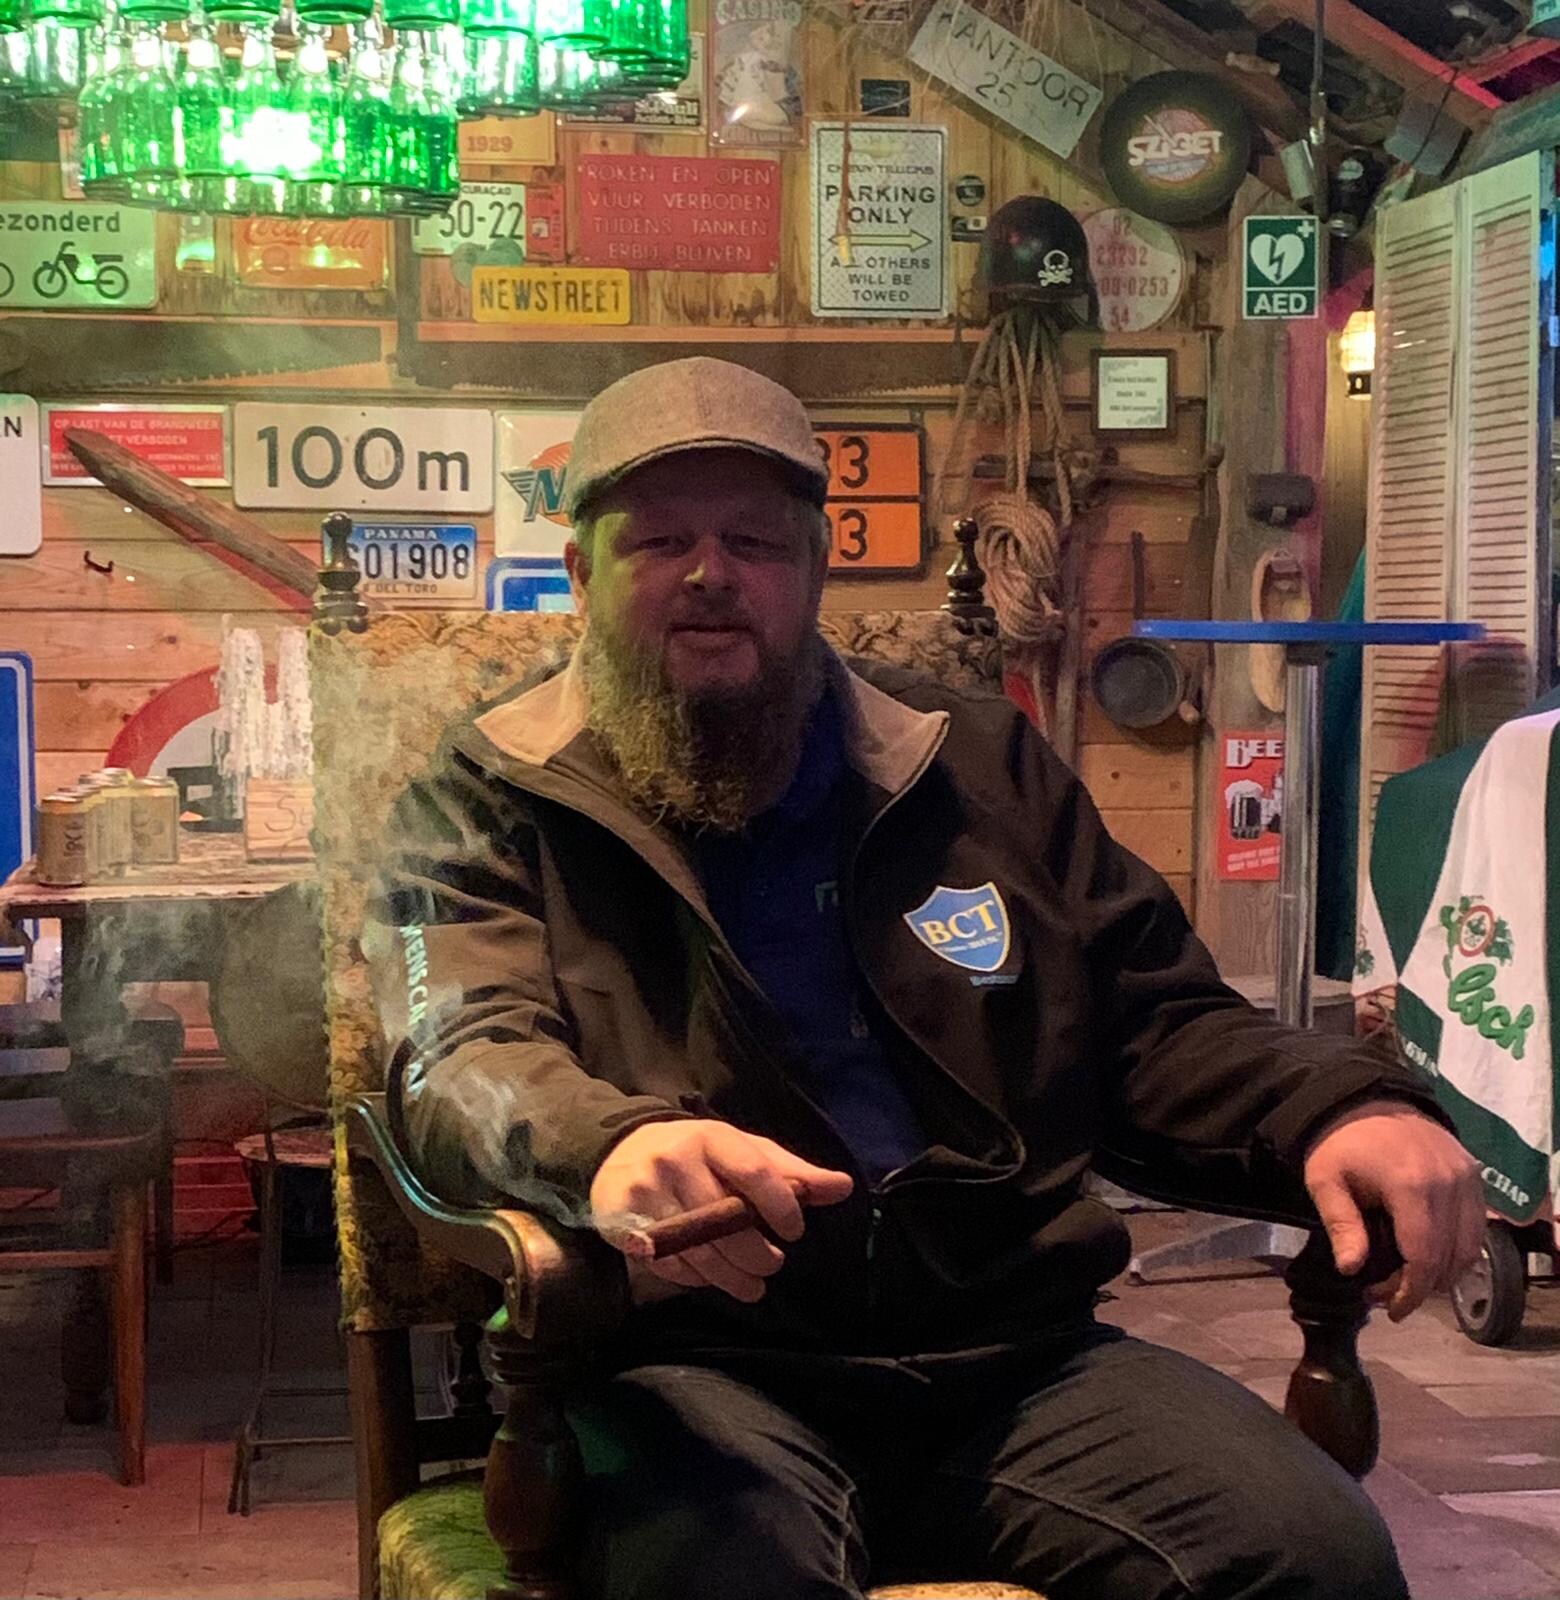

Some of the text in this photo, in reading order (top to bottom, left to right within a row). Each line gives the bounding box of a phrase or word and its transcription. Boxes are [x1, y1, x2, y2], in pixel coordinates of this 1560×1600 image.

[467, 135, 513, 152] 1929
[587, 163, 771, 185] ROKEN EN OPEN
[588, 191, 771, 210] VUUR VERBODEN
[848, 206, 913, 224] ONLY
[692, 218, 767, 235] TANKEN
[865, 256, 931, 270] OTHERS
[849, 273, 913, 286] WILL BE
[480, 277, 622, 313] NEWSTREET
[852, 290, 910, 302] TOWED
[1254, 293, 1307, 315] AED
[0, 416, 23, 438] N
[103, 420, 127, 429] VAN
[130, 420, 145, 429] DE
[363, 529, 438, 541] PANAMA
[375, 583, 399, 594] DEL
[919, 900, 998, 945] BCT
